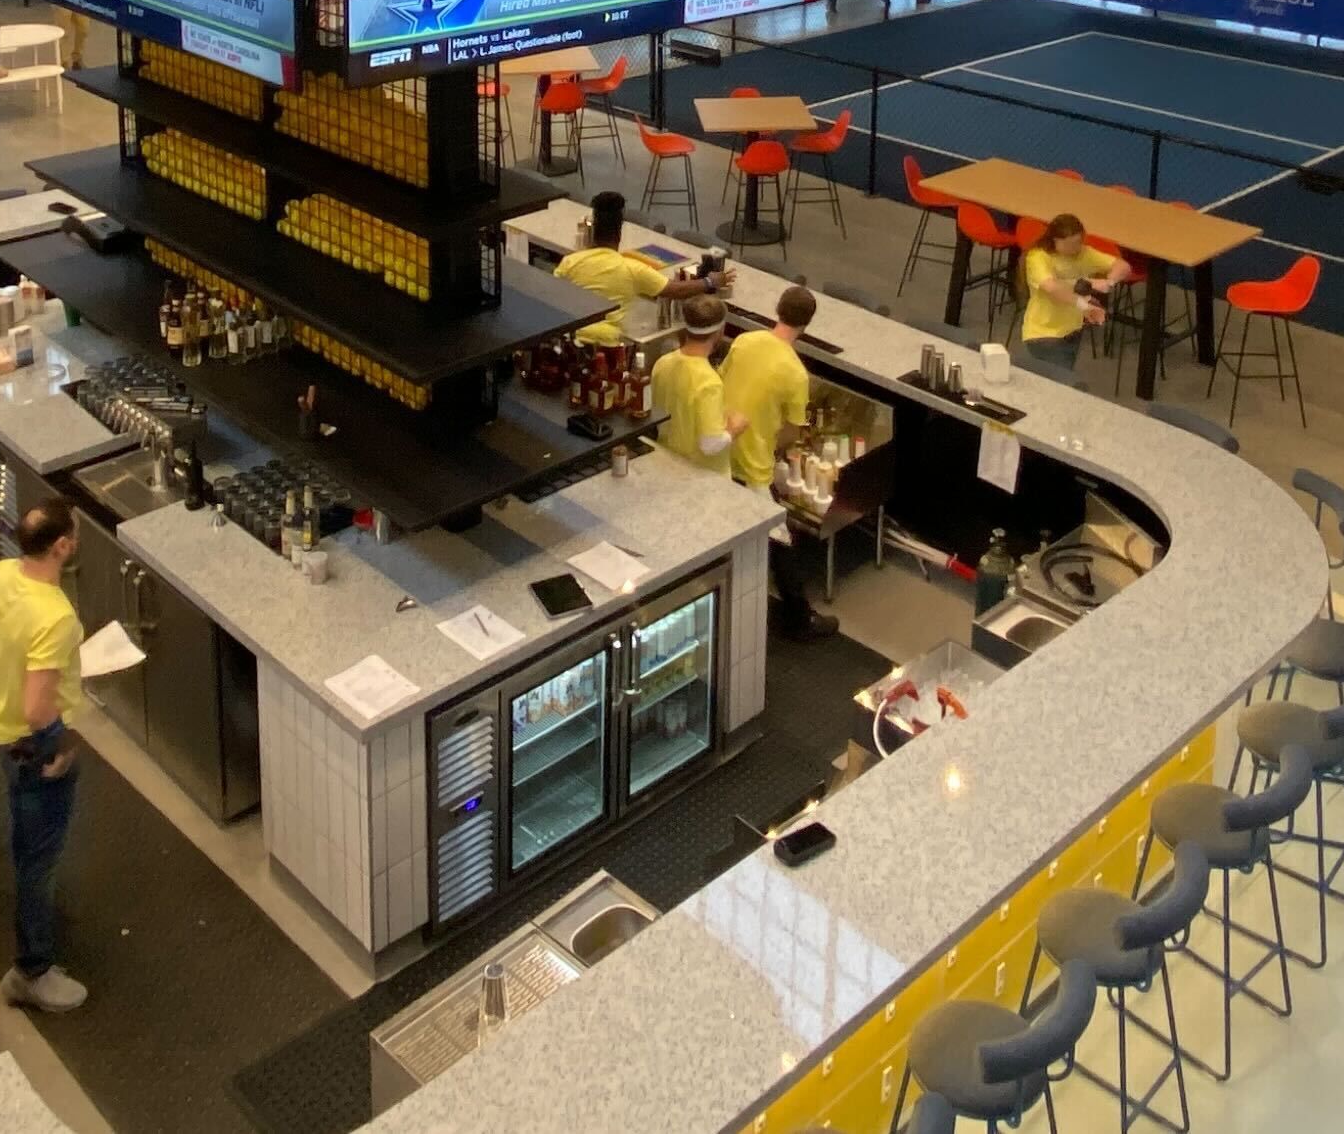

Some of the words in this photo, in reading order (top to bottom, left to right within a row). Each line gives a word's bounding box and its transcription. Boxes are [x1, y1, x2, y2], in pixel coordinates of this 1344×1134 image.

[452, 34, 489, 50] Hornets
[502, 26, 532, 41] Lakers
[369, 47, 412, 67] ESPN
[421, 43, 440, 55] NBA
[452, 49, 470, 61] LAL
